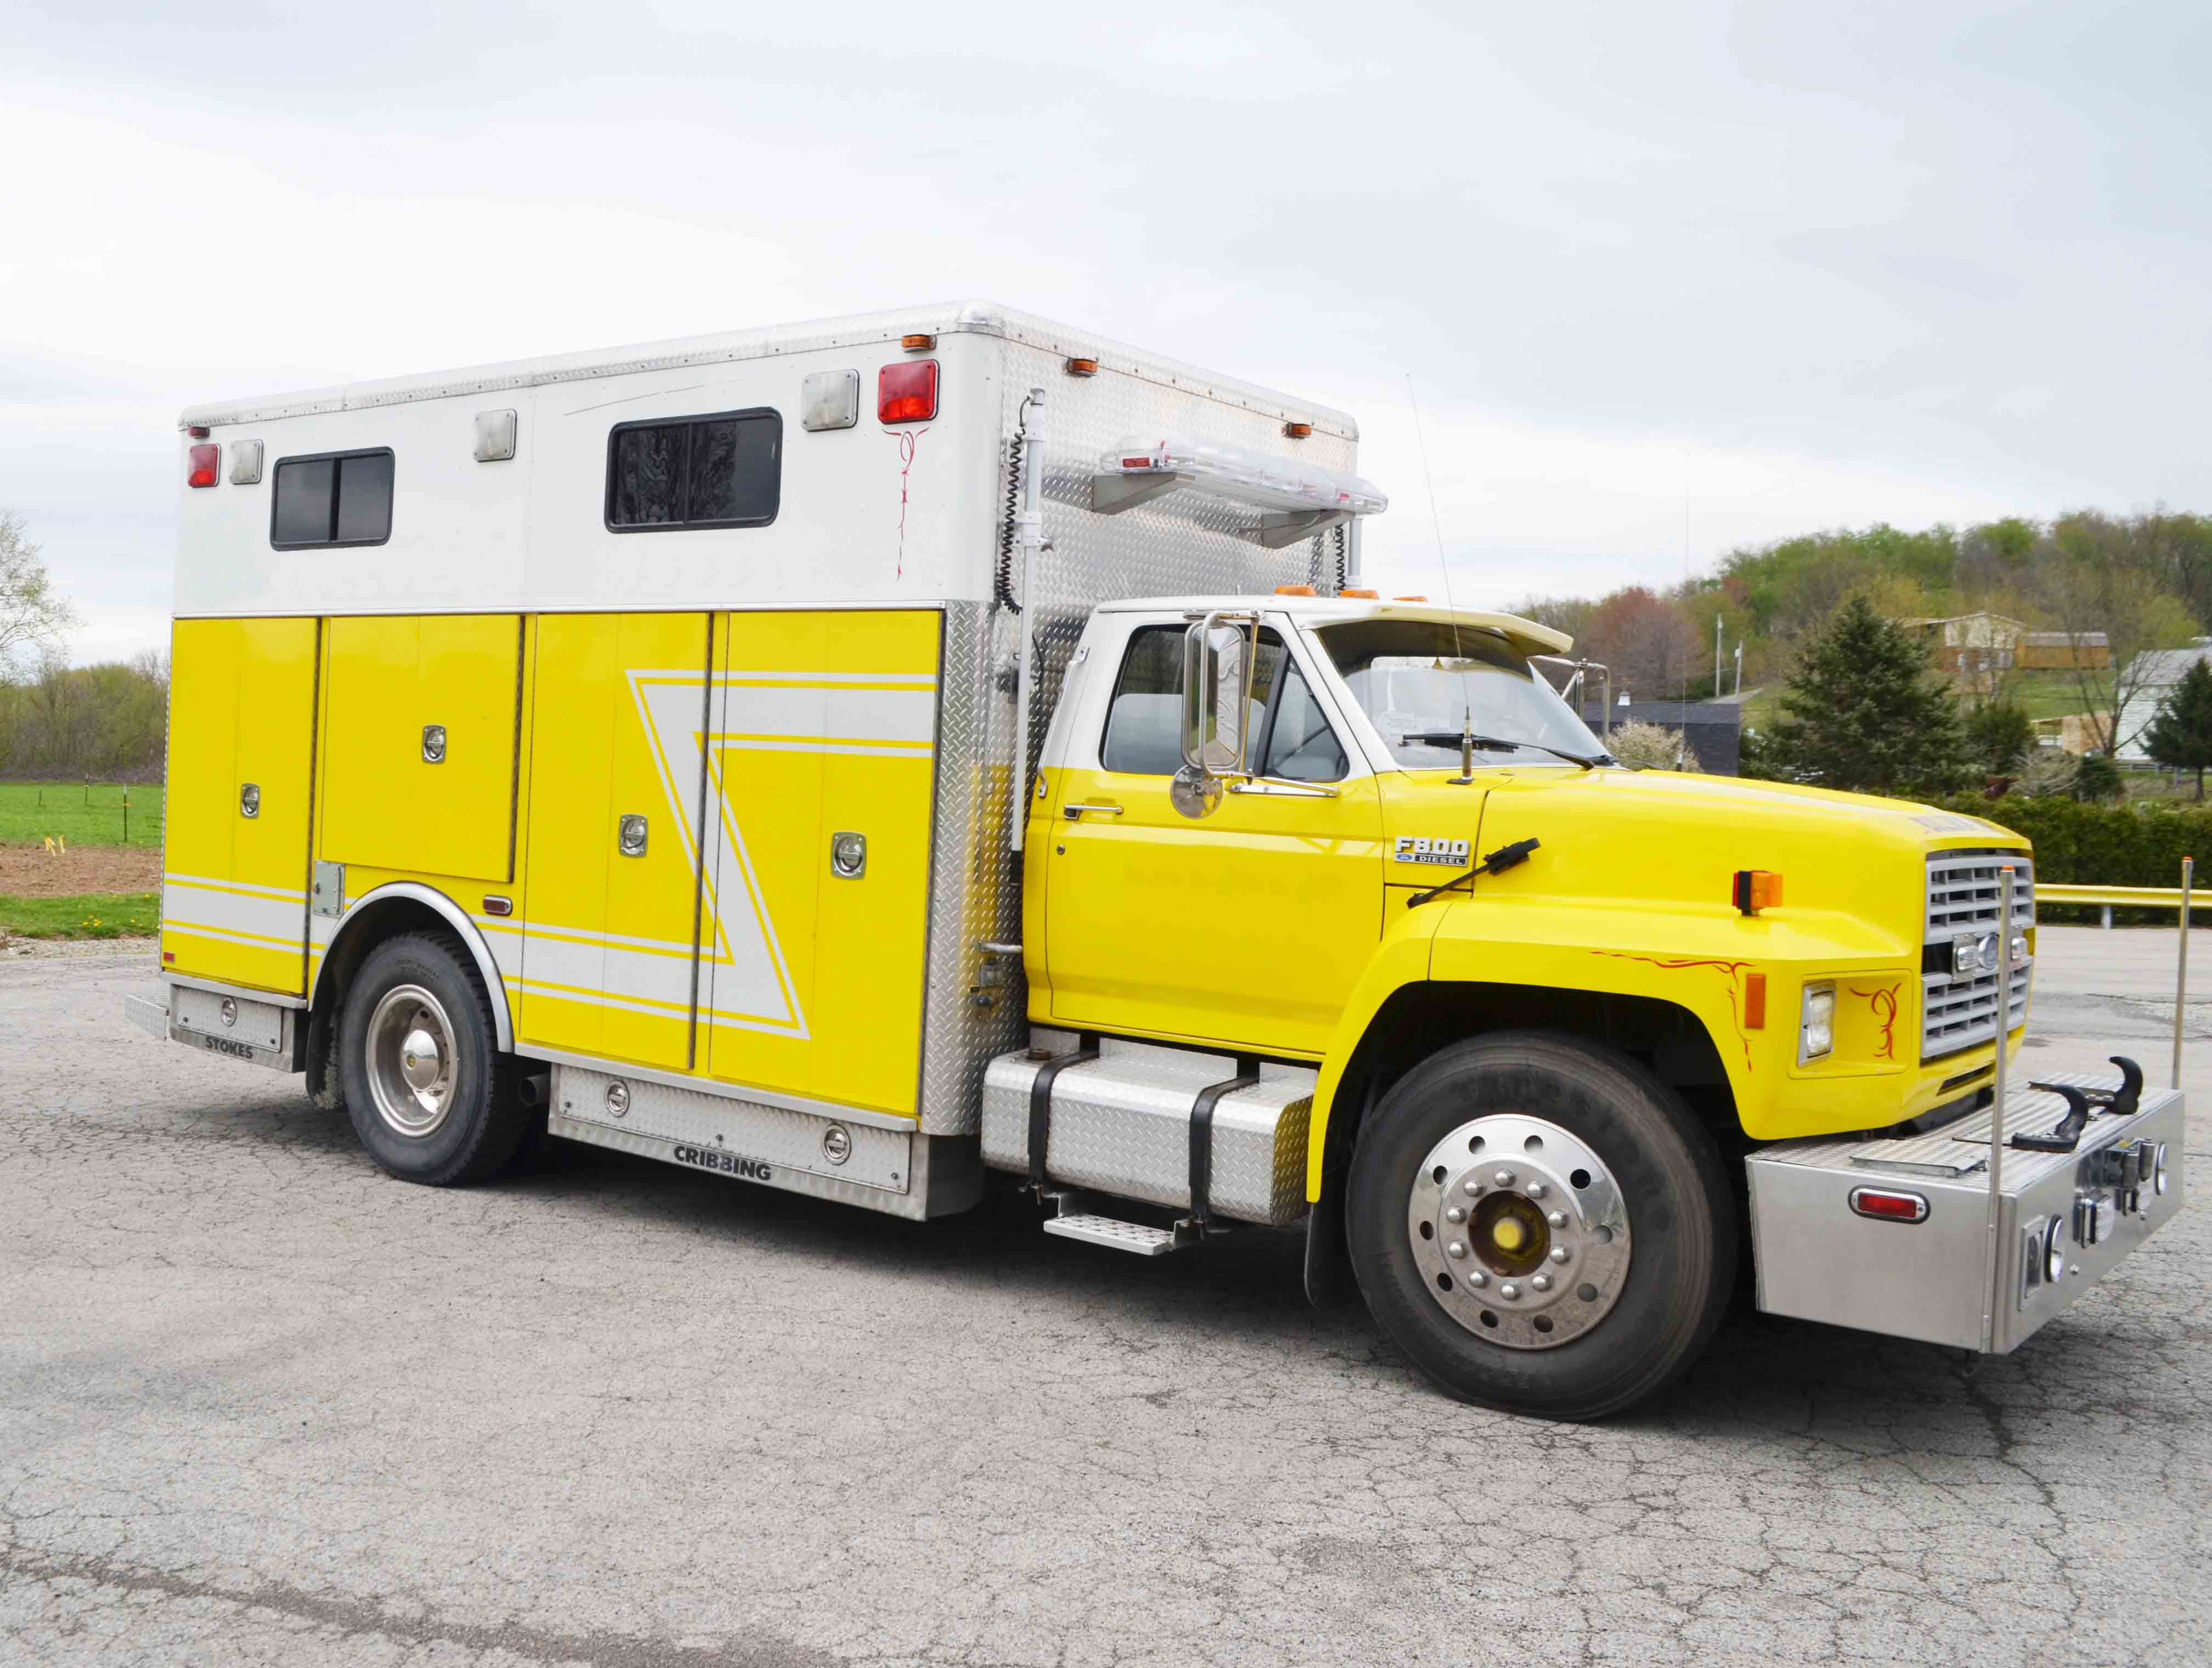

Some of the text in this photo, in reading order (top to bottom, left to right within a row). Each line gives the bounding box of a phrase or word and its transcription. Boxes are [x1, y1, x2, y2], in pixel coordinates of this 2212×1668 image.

[1395, 836, 1469, 856] F800
[1419, 856, 1463, 865] DIESEL
[206, 1035, 253, 1059] STOKES
[674, 1146, 771, 1180] CRIBBING
